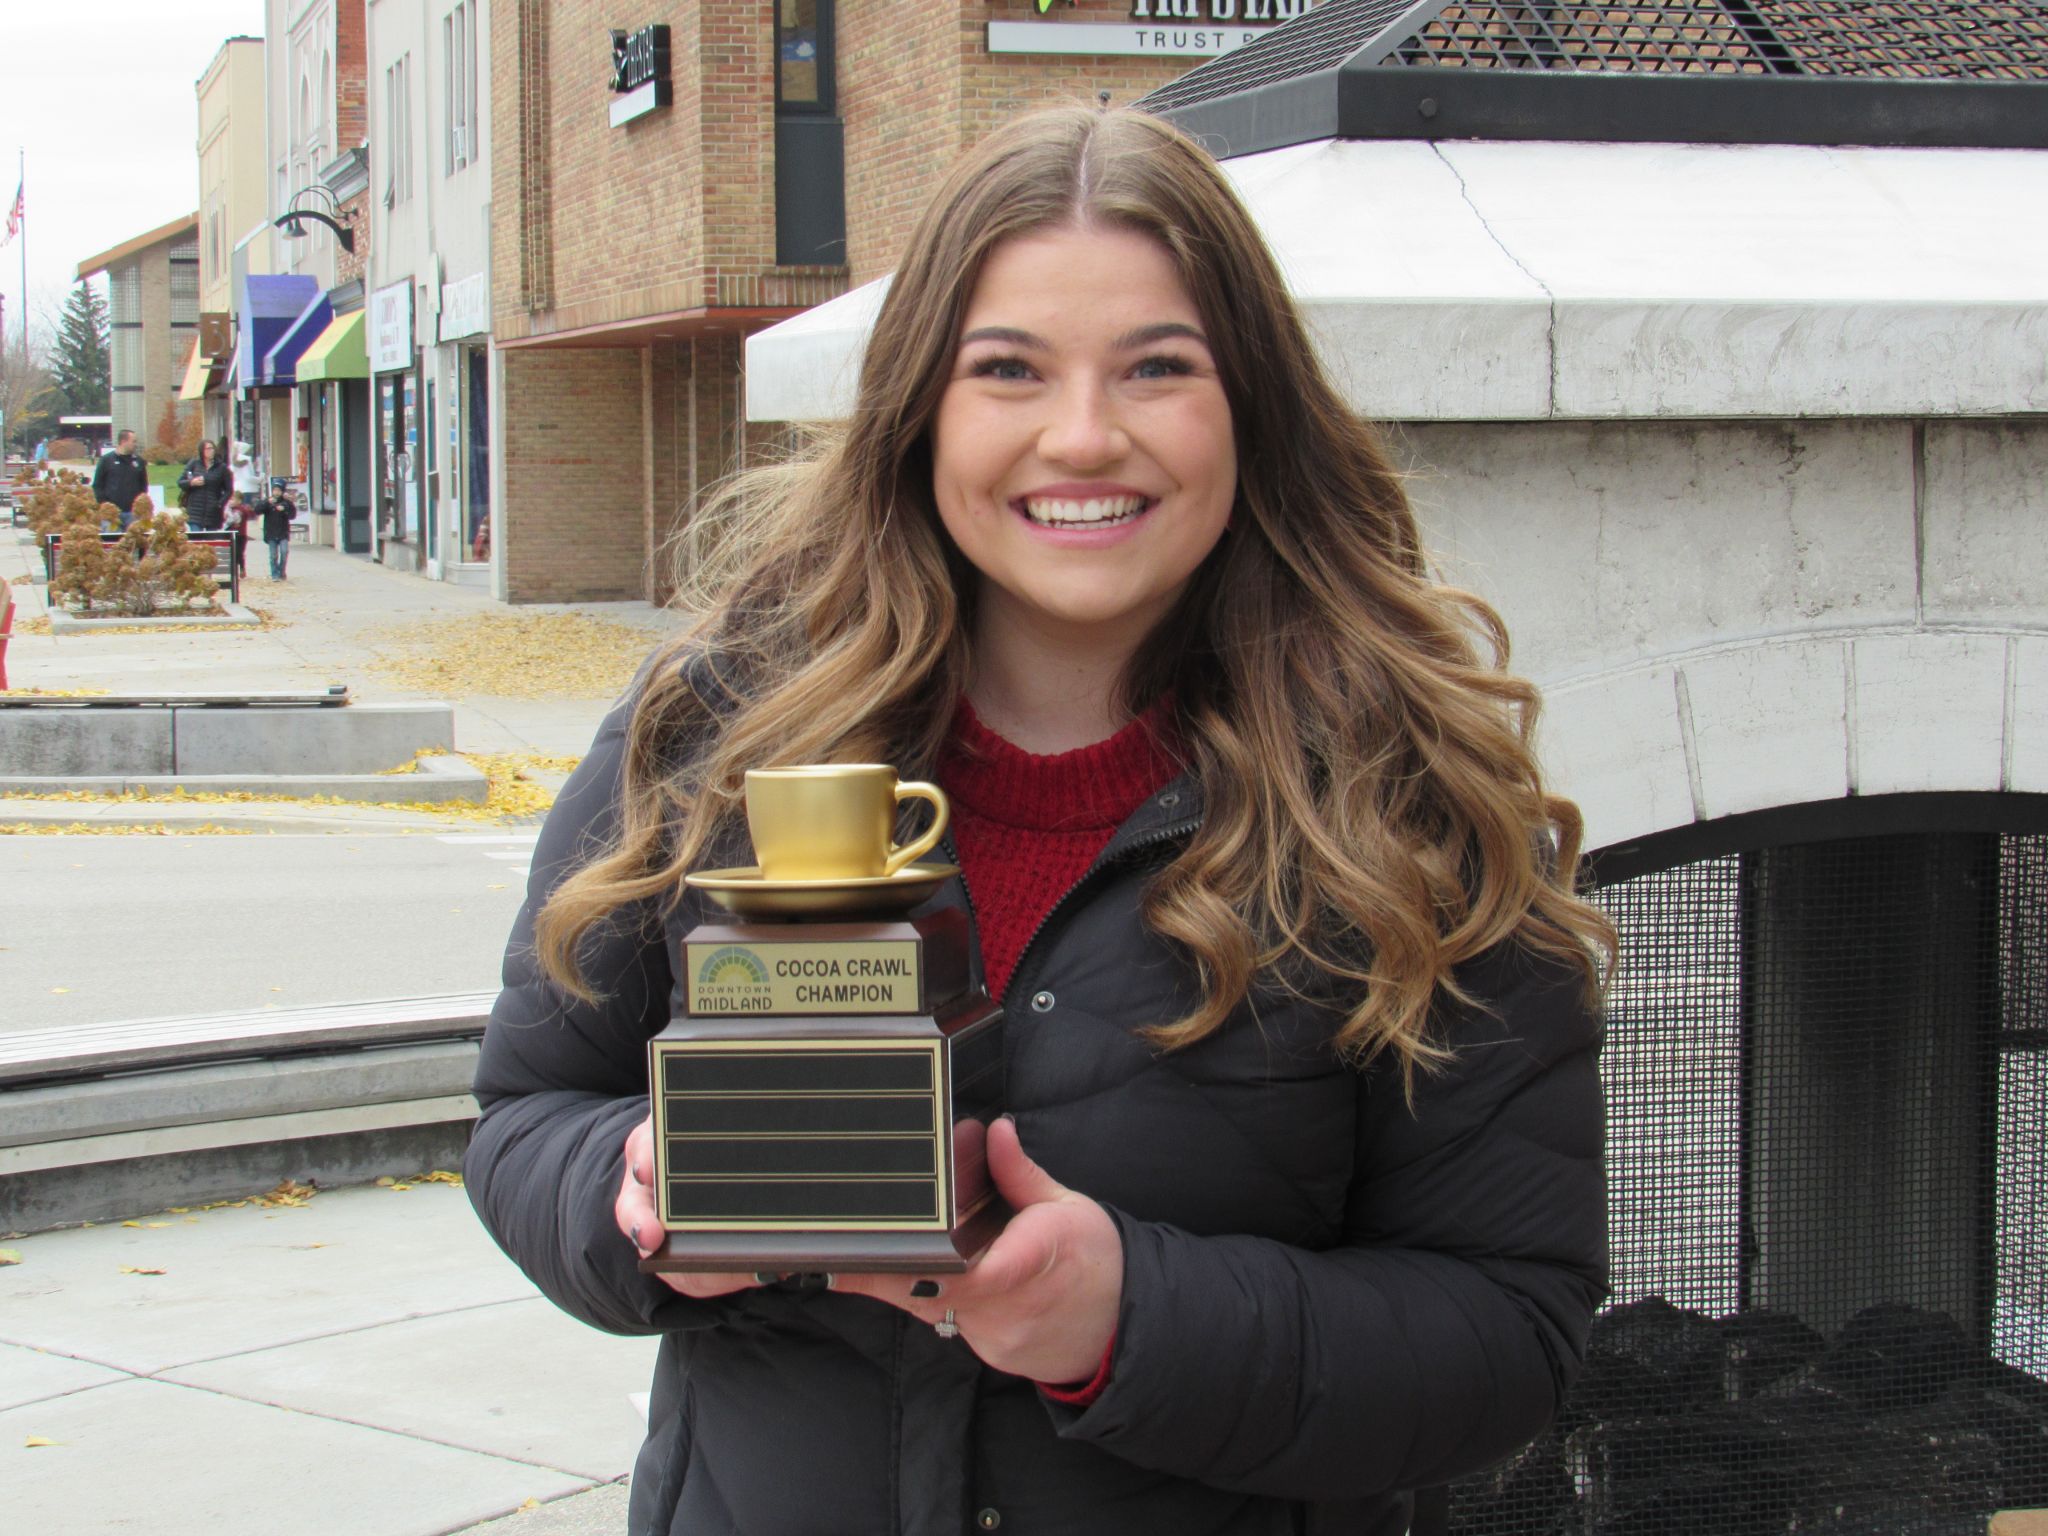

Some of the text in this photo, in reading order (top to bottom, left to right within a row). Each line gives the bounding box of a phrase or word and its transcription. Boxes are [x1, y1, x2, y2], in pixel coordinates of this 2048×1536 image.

[1136, 31, 1225, 49] TRUST
[775, 958, 912, 978] COCOA CRAWL
[698, 985, 772, 995] DOWNTOWN
[795, 984, 893, 1003] CHAMPION
[698, 996, 773, 1012] MIDLAND
